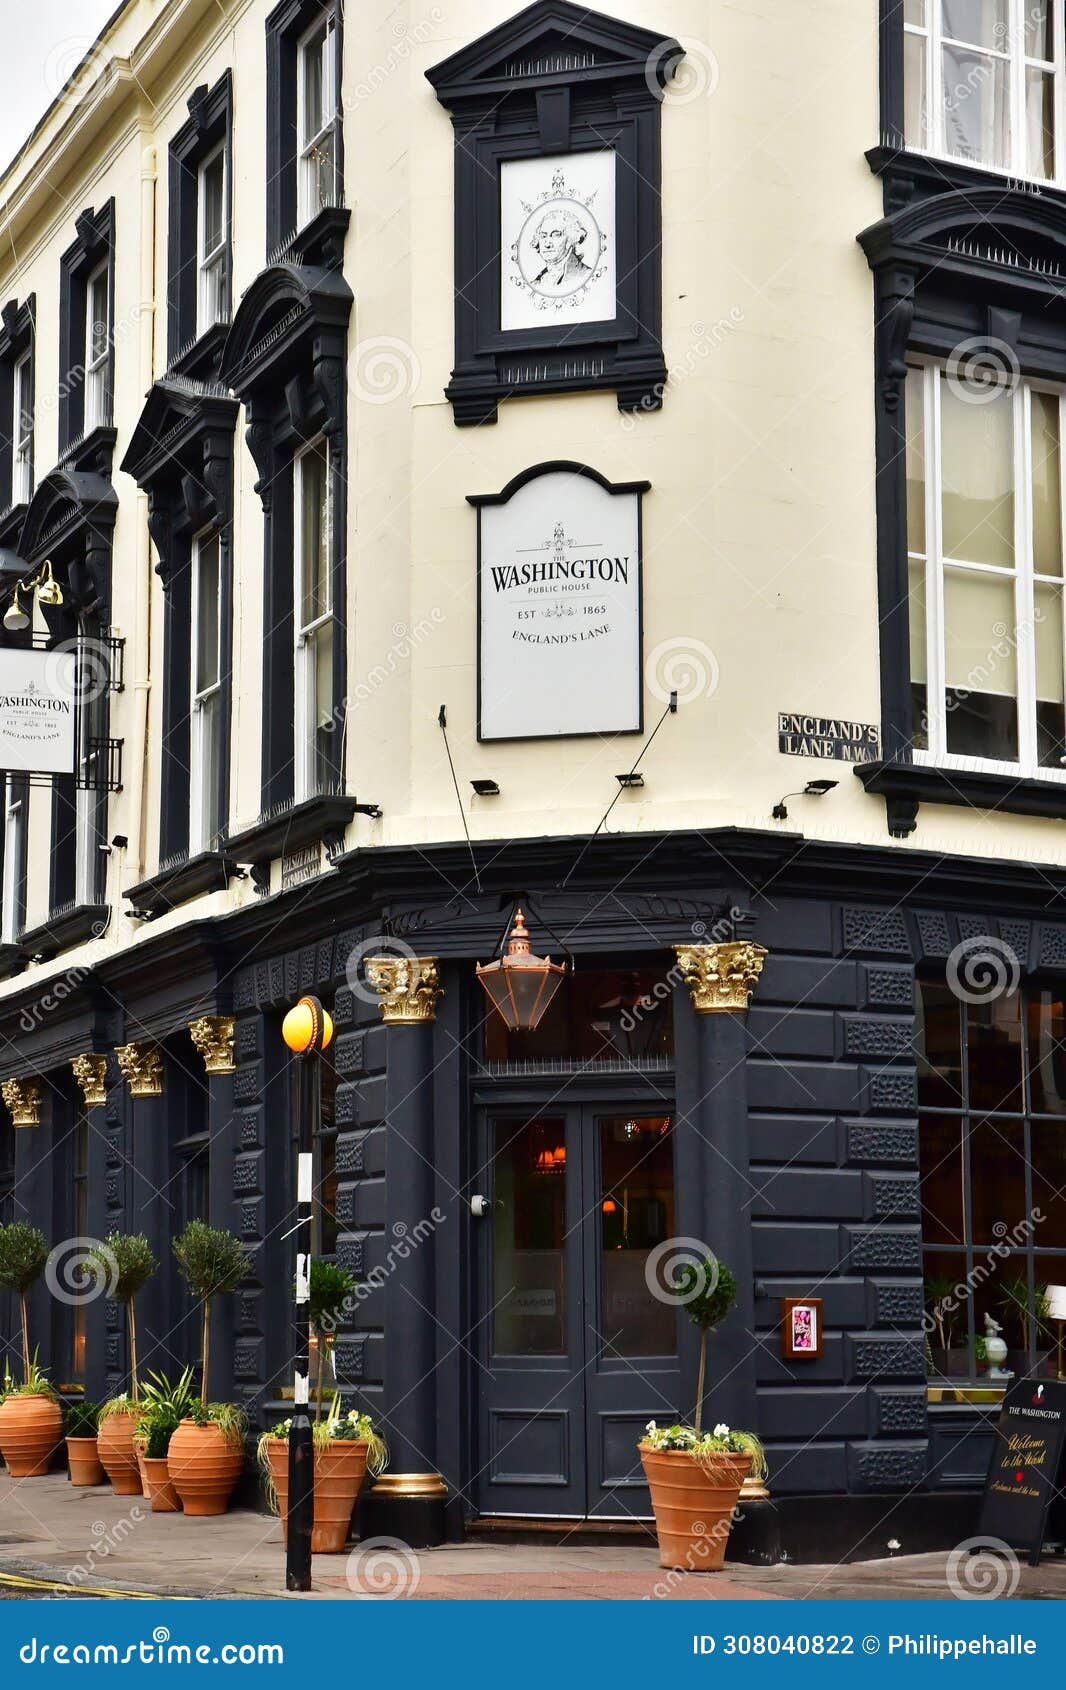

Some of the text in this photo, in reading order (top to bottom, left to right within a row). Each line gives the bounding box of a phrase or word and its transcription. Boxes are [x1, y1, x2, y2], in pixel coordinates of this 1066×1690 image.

[491, 557, 629, 593] WASHINGTON
[528, 583, 591, 594] PUBLIC HOUSE
[518, 605, 606, 620] EST 1865
[512, 624, 611, 644] ENGLAND'S LANE
[779, 715, 878, 743] ENGLAND'S
[786, 736, 834, 758] LANE
[1022, 1409, 1060, 1419] WASHINGTON
[1009, 1434, 1044, 1449] Welcome
